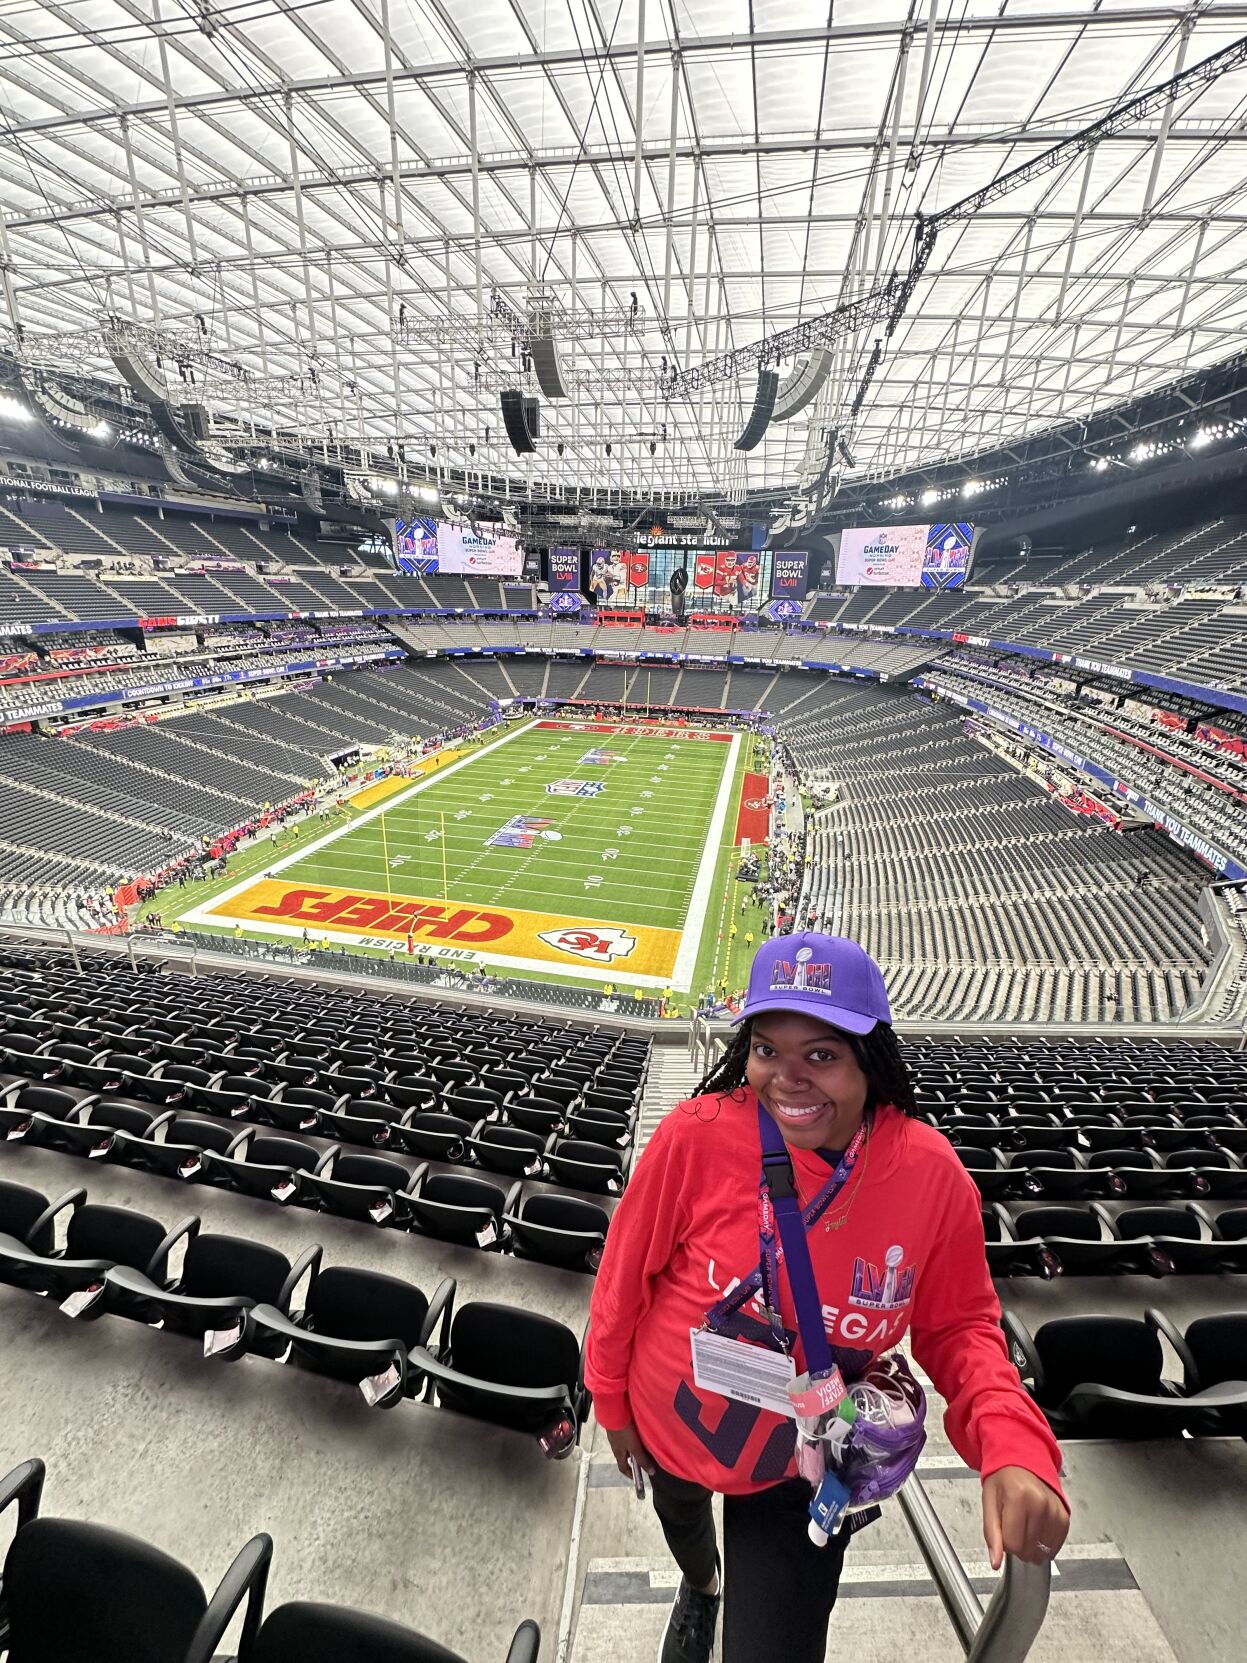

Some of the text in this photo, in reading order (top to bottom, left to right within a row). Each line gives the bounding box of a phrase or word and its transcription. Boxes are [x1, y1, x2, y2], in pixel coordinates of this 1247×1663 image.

[31, 482, 70, 494] FOOTBALL
[71, 488, 100, 498] LEAGUE
[680, 534, 730, 546] staium
[864, 546, 900, 554] GAMEDAY
[551, 556, 578, 564] SUPER
[776, 561, 804, 569] SUPER
[552, 564, 578, 572] BOWL
[776, 570, 803, 578] BOWL
[128, 684, 163, 698] COUNTDOWN
[6, 702, 63, 720] TEAMMATES
[1143, 800, 1228, 871] THANK YOU TEAMMATES
[584, 875, 603, 888] 10
[250, 890, 514, 942] CHIEFS
[358, 937, 477, 960] END RCISM
[849, 1126, 866, 1158] GAMEDAY
[856, 1299, 886, 1309] SUPER
[822, 1305, 904, 1342] EGAS
[816, 1376, 840, 1397] MEDIA
[821, 1384, 844, 1408] STAFF/
